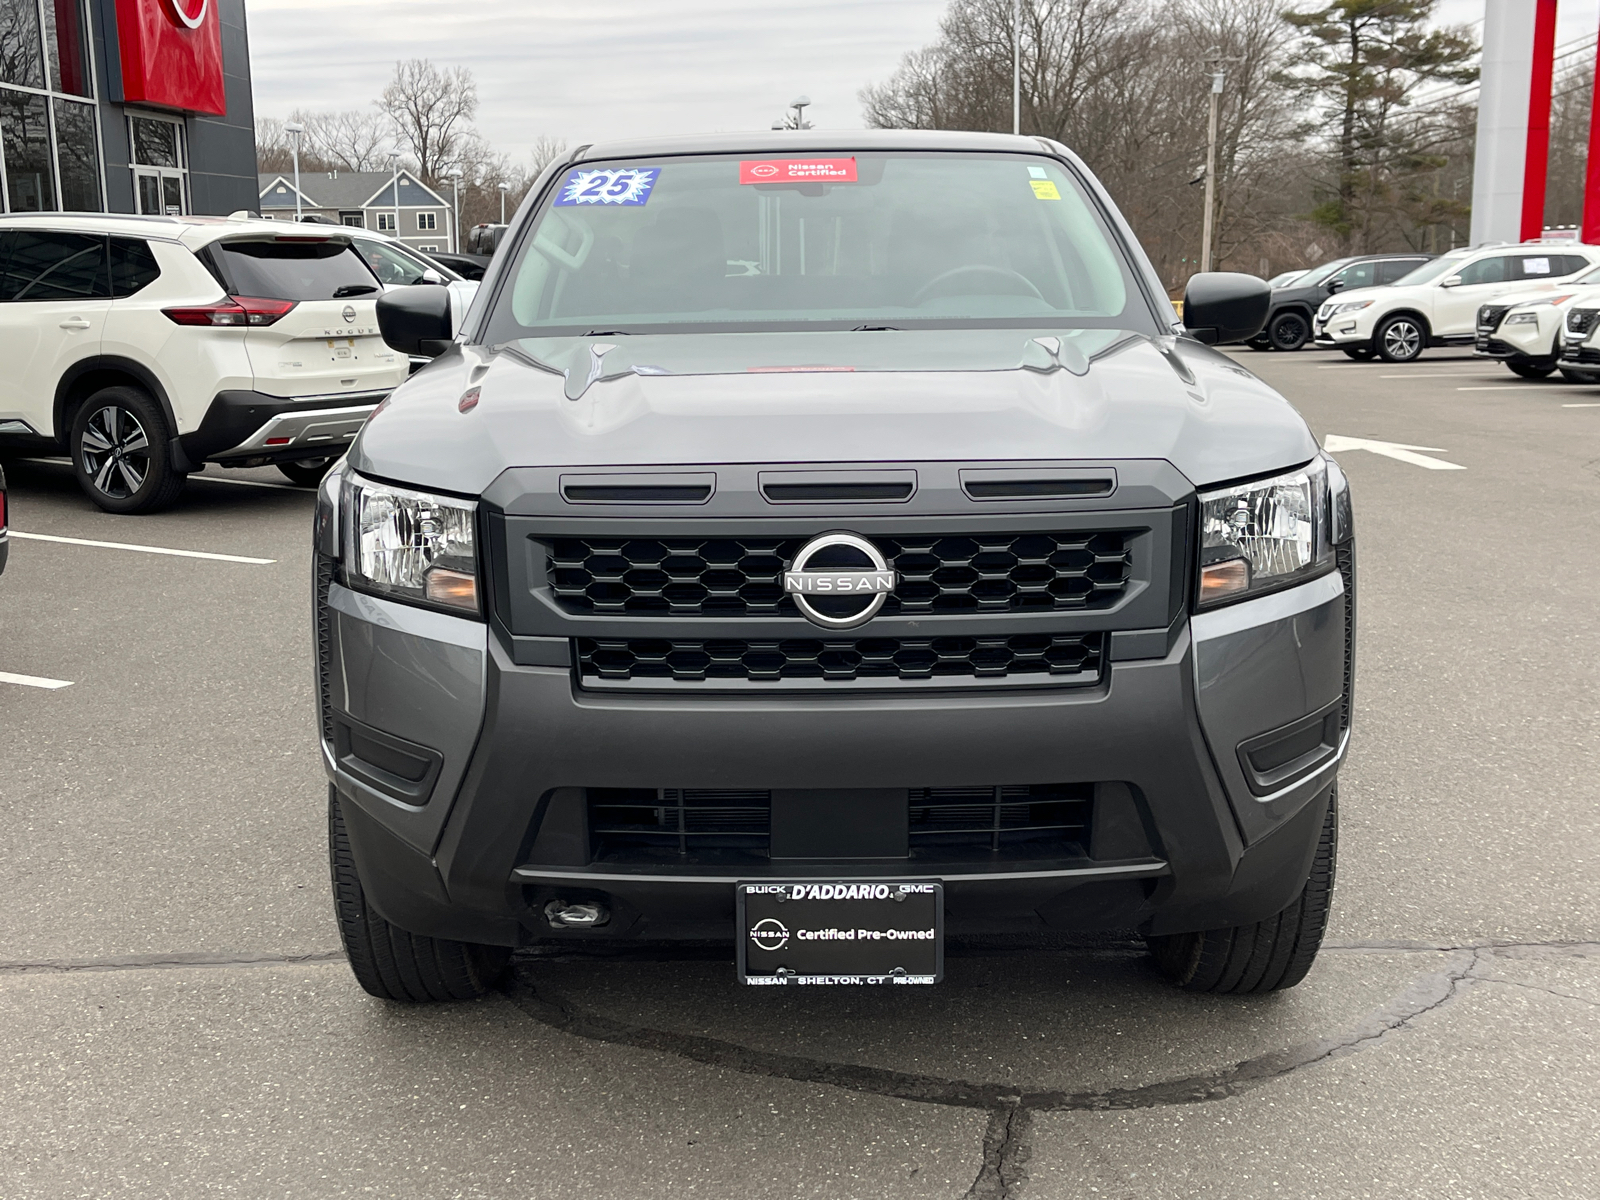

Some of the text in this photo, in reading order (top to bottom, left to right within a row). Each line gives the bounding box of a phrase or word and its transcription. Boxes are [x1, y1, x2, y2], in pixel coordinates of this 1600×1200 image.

[580, 175, 634, 196] 25
[787, 576, 893, 591] NISSAN
[746, 886, 786, 894] BUICK
[792, 884, 889, 900] D'ADDARIO
[899, 885, 934, 893] GMC
[797, 928, 935, 940] Certified Pre-Owned
[747, 977, 787, 985] NISSAN
[798, 977, 864, 986] SHELTON,
[867, 977, 886, 985] CT
